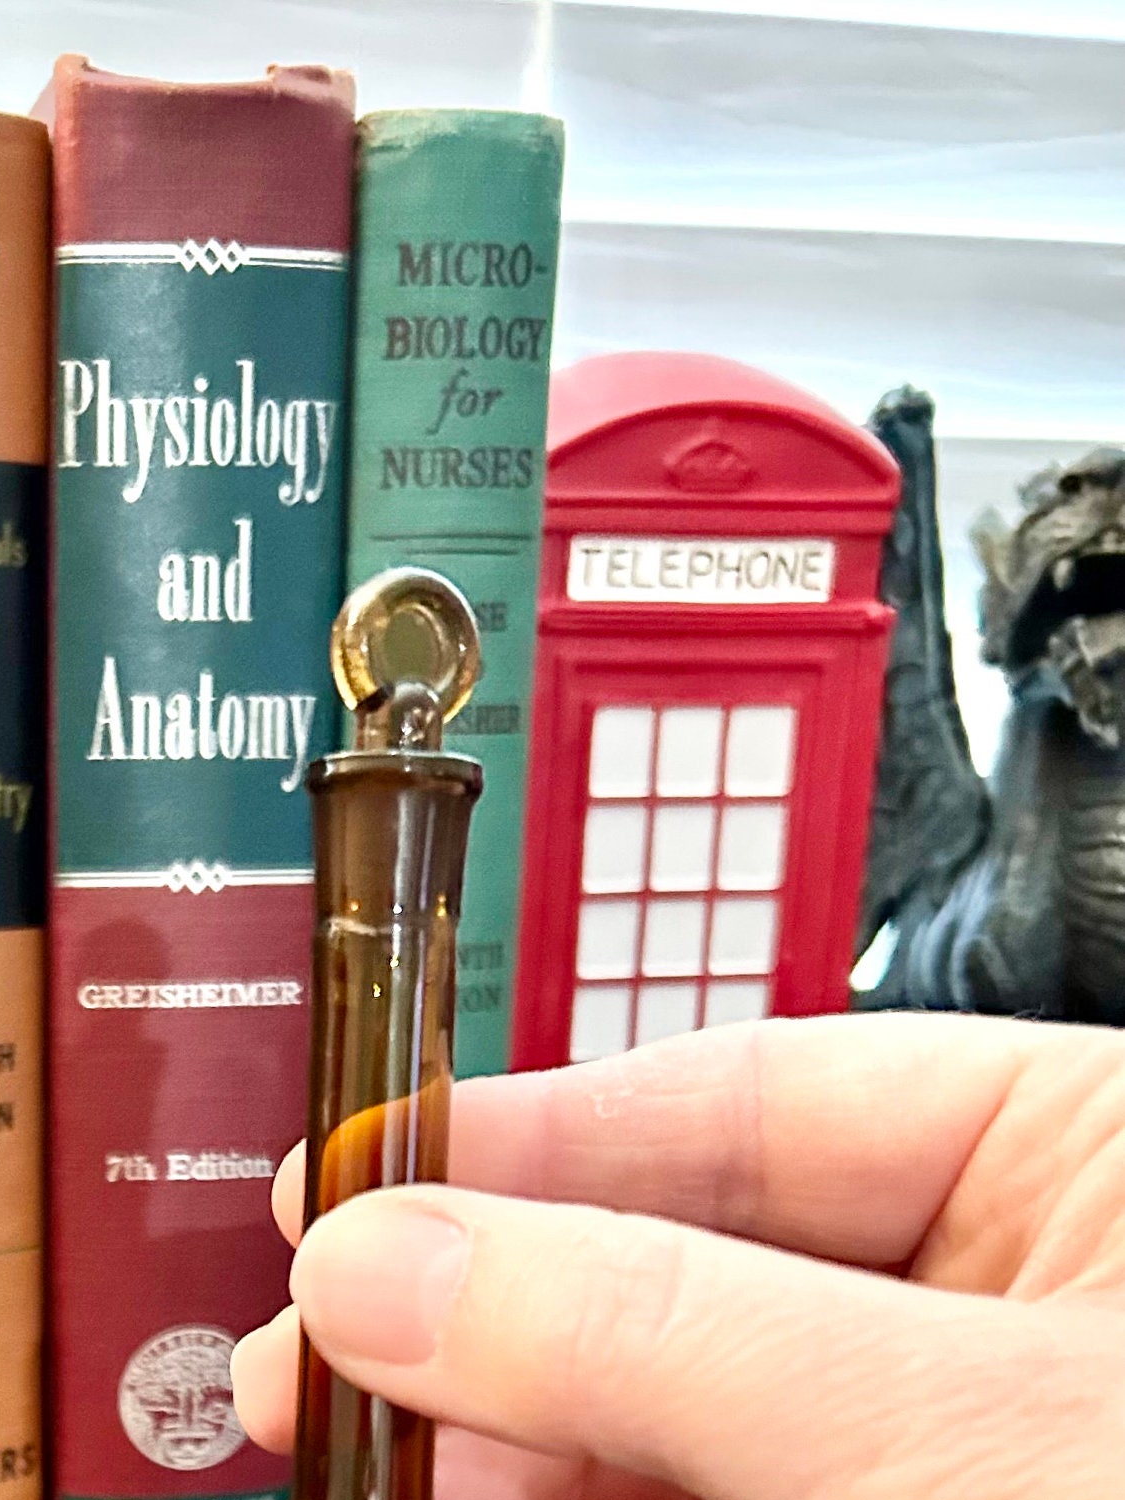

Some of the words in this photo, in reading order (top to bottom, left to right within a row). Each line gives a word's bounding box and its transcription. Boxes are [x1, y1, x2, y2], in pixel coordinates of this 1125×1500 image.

[397, 242, 549, 288] MICRO-
[384, 316, 547, 363] BIOLOGY
[427, 367, 503, 436] for
[57, 359, 336, 504] Physiology
[378, 448, 533, 491] NURSES
[156, 519, 252, 624] and
[580, 546, 826, 591] TELEPHONE
[87, 656, 316, 793] Anatomy
[78, 980, 302, 1010] GREISHEIMER
[105, 1153, 156, 1182] 7th
[166, 1152, 275, 1182] Edition
